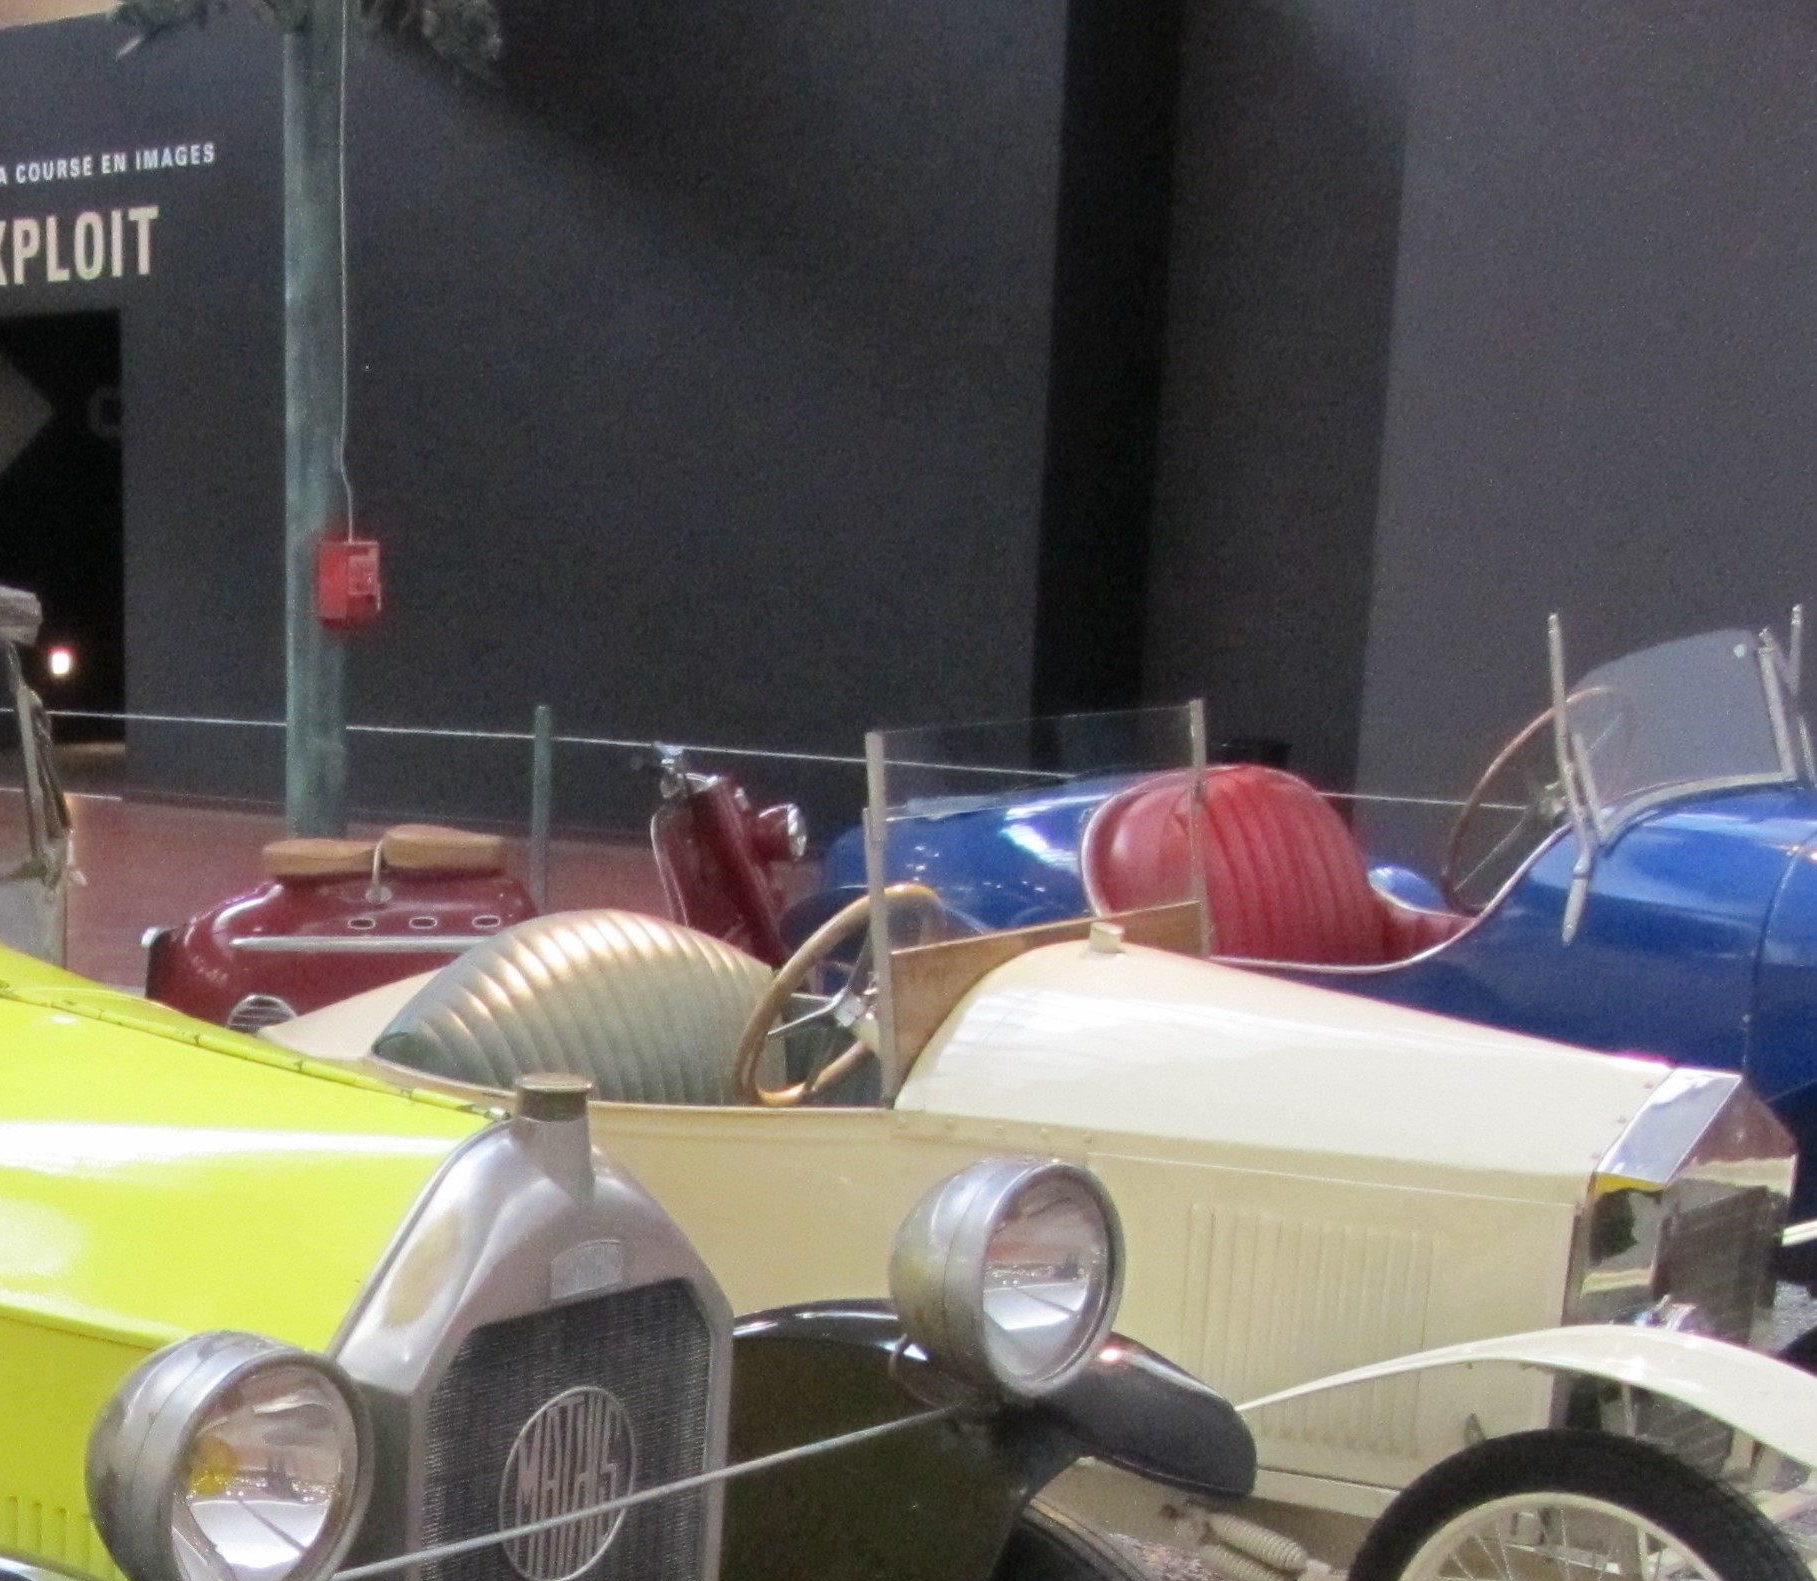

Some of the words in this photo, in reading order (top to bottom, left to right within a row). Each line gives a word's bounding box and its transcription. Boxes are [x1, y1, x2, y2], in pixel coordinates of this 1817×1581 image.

[15, 155, 94, 184] COURSE
[101, 152, 127, 174] EN
[135, 142, 216, 171] IMAGES
